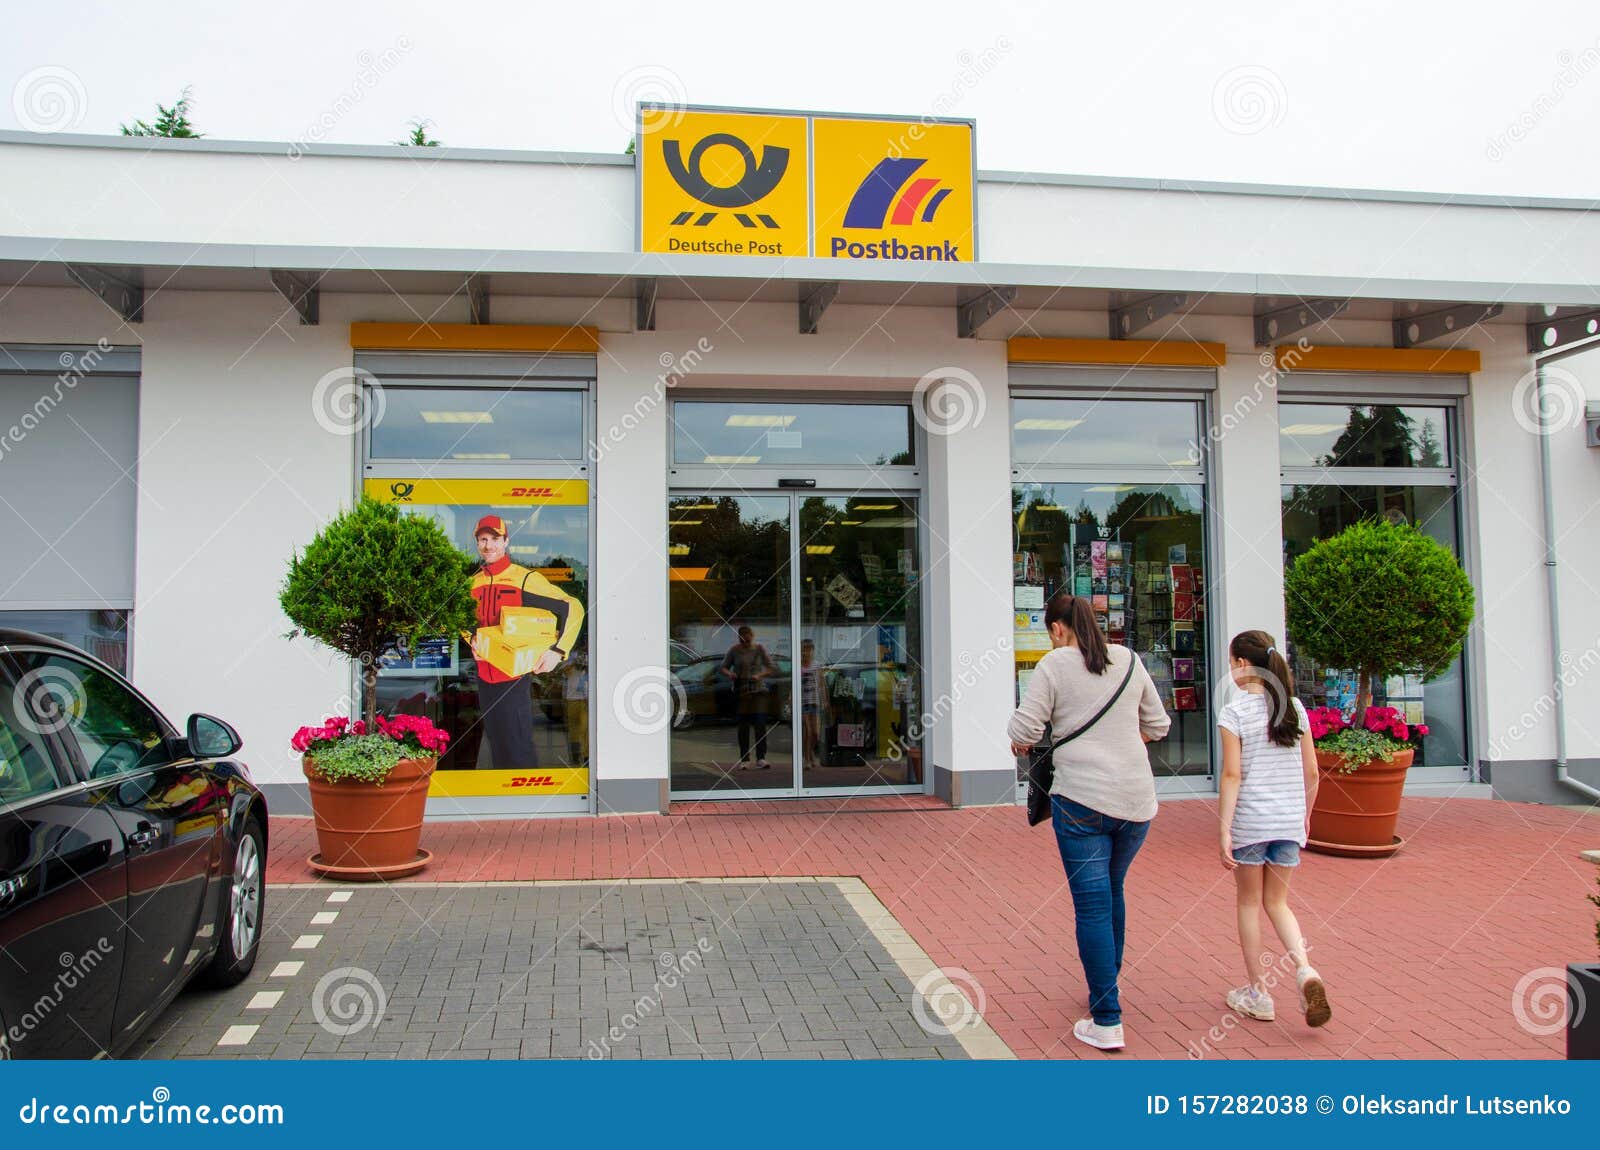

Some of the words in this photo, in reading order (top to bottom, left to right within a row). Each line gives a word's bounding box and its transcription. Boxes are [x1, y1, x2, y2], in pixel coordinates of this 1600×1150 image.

[669, 238, 743, 254] Deutsche
[749, 241, 782, 254] Post
[831, 237, 960, 261] Postbank
[510, 487, 554, 497] DHL
[510, 776, 555, 787] DHL
